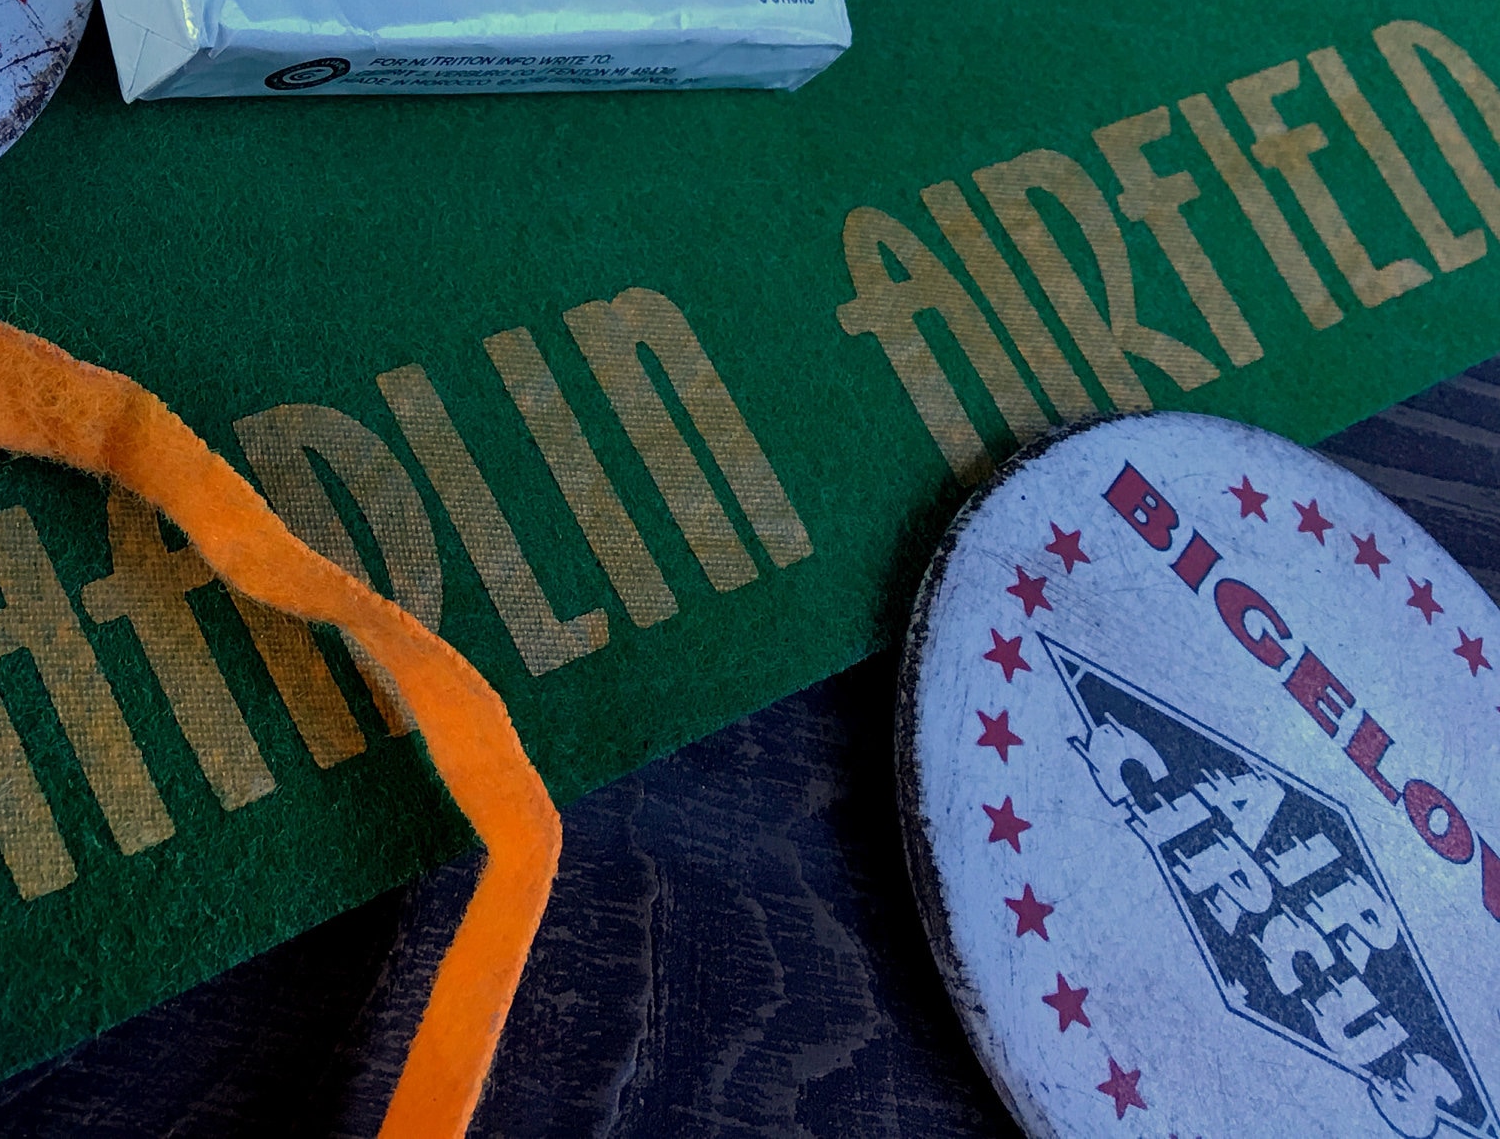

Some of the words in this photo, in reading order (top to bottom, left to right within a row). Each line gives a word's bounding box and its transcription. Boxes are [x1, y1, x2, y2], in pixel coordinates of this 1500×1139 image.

[368, 57, 408, 67] FOR
[407, 55, 498, 67] NUTRITION
[495, 55, 537, 66] INFO
[538, 55, 590, 65] WRITE
